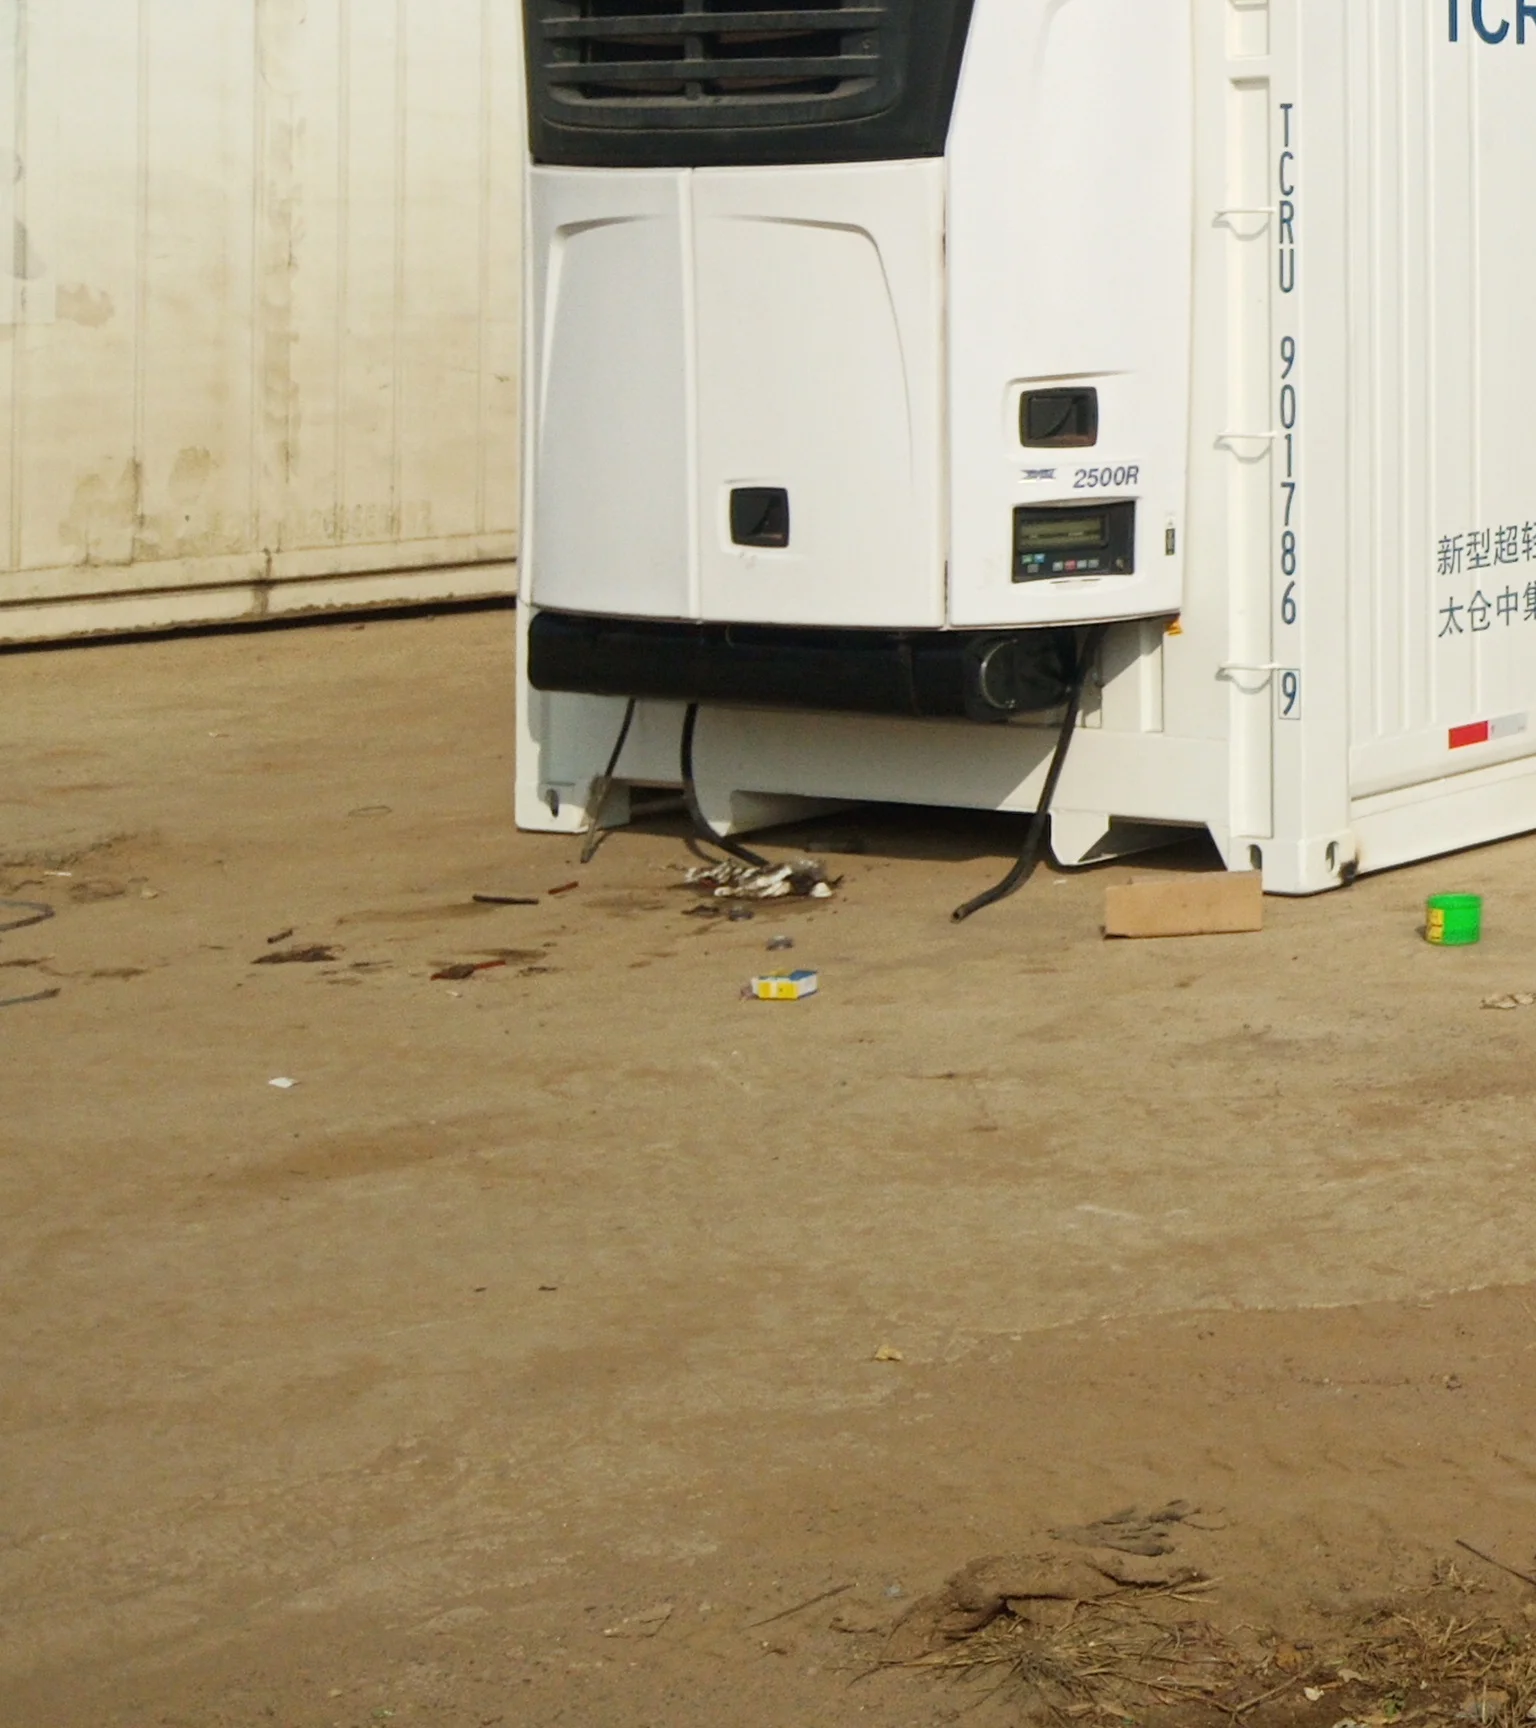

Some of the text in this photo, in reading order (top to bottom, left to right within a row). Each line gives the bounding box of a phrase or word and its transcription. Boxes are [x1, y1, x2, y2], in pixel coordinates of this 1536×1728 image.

[1072, 465, 1140, 489] 2500R
[1277, 104, 1298, 718] TCRU 901786 9
